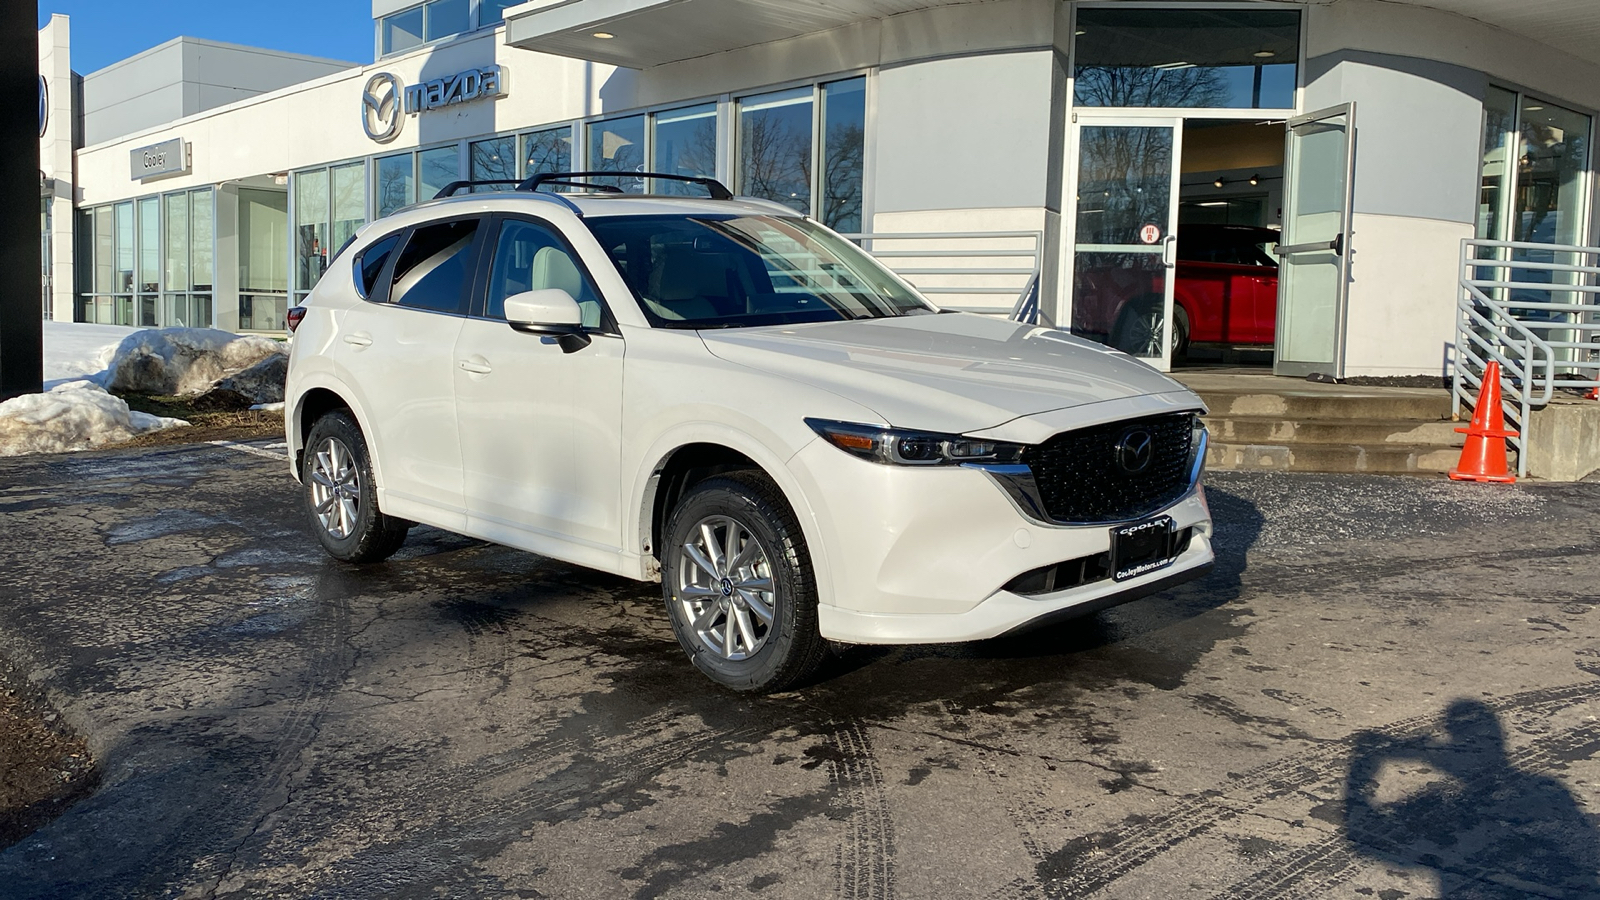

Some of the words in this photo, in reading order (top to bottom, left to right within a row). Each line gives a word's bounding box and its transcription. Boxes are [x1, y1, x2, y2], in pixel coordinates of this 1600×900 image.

[404, 64, 505, 114] mazda
[143, 146, 167, 170] Cooley
[1120, 517, 1170, 534] COOLEY
[1116, 558, 1169, 579] CooleyMotors.com
